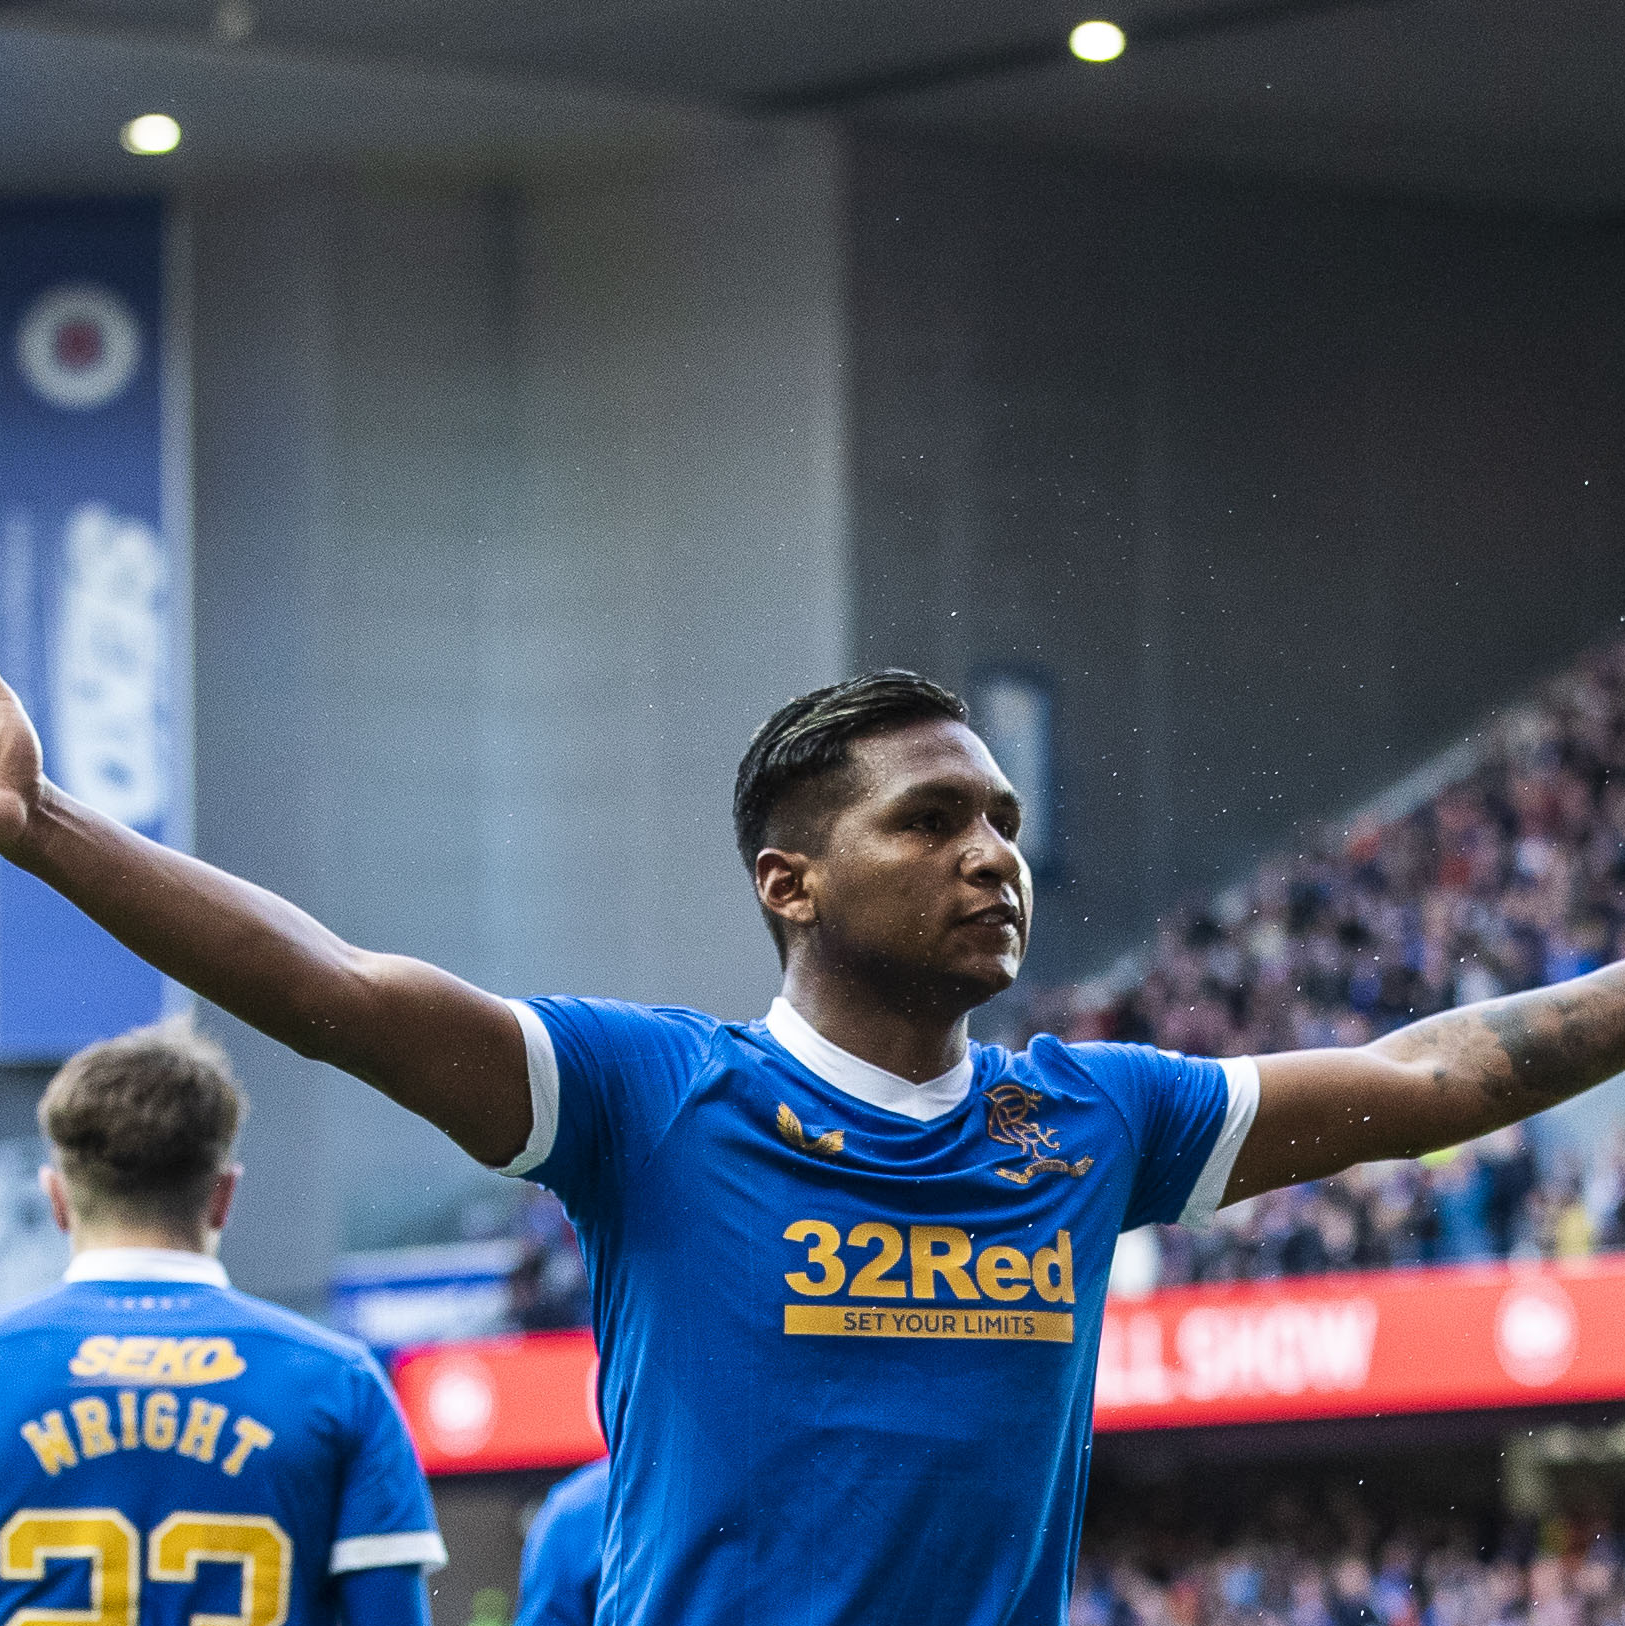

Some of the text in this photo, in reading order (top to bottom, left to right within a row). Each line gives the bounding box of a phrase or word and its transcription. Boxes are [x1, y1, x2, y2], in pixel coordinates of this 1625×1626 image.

[782, 1219, 1076, 1304] 32Red
[843, 1311, 1036, 1336] SET YOUR LIMITS
[1177, 1301, 1377, 1400] SHOW
[21, 1392, 275, 1477] WRIGHT
